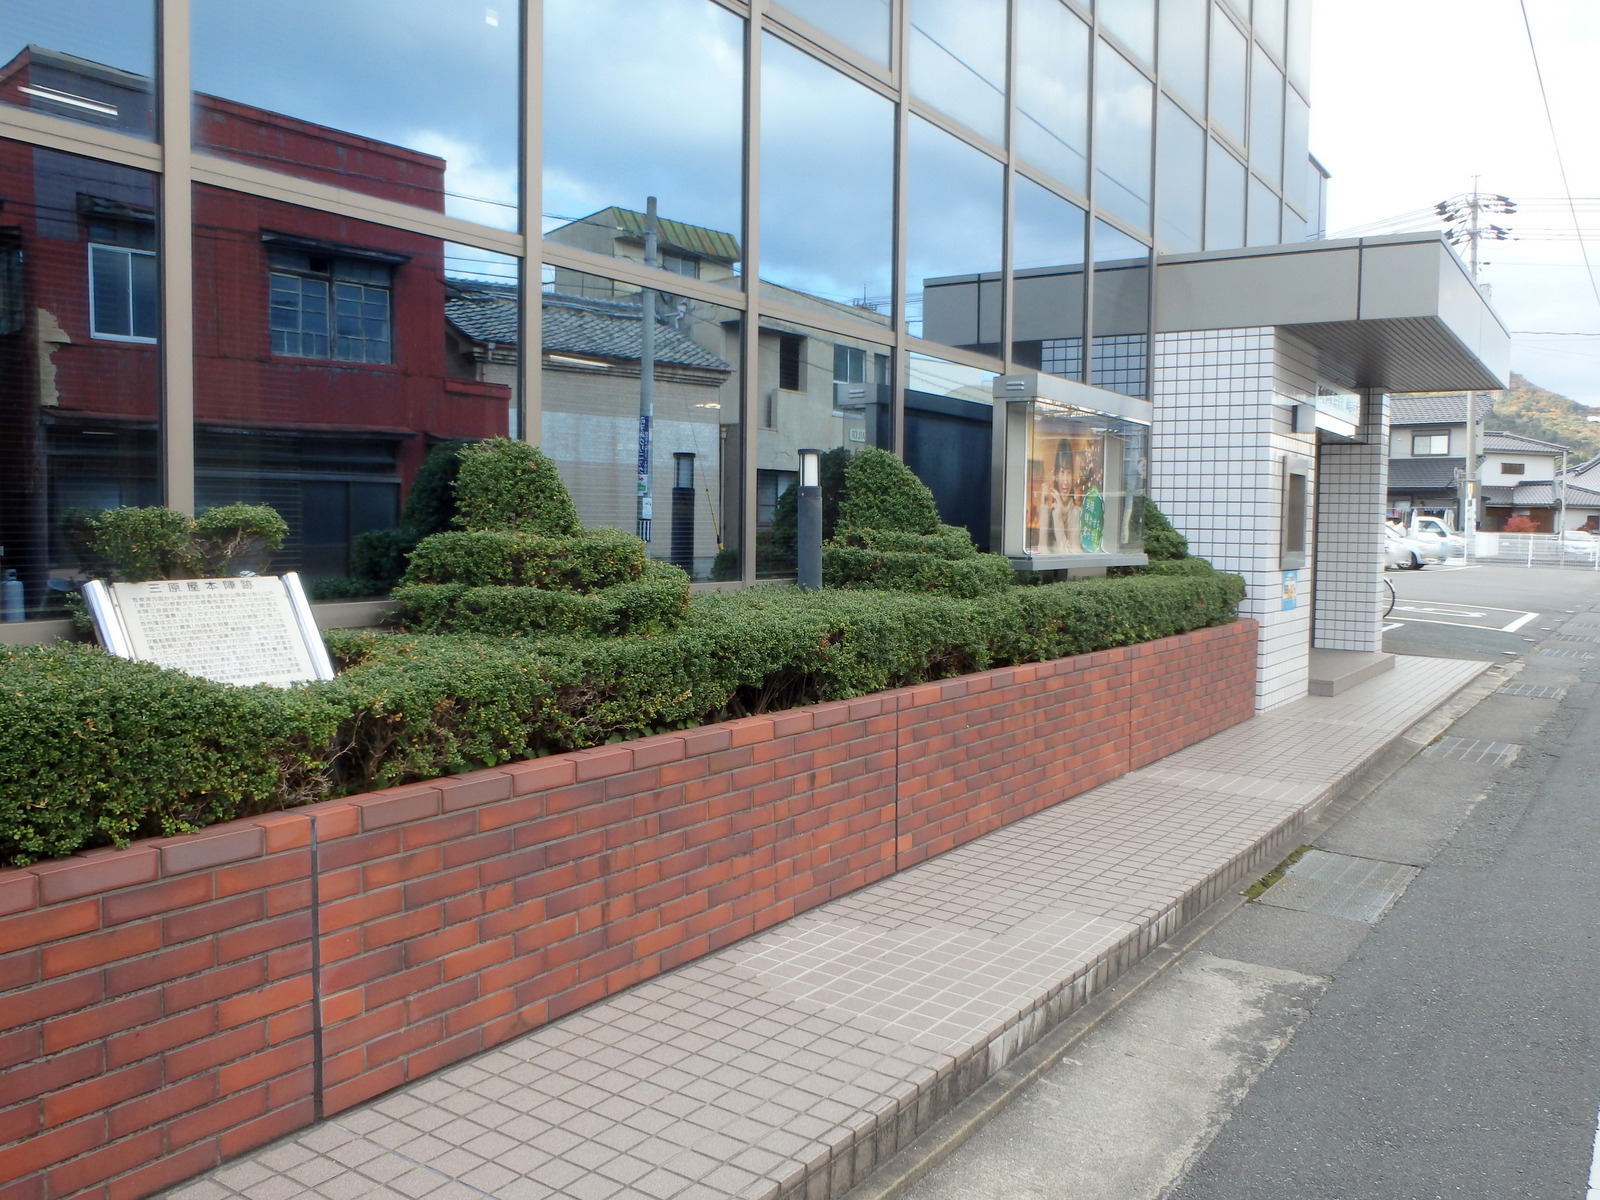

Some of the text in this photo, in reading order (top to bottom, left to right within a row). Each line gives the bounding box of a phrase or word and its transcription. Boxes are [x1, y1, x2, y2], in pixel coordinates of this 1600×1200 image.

[147, 580, 254, 593] 三原屋本陣跡
